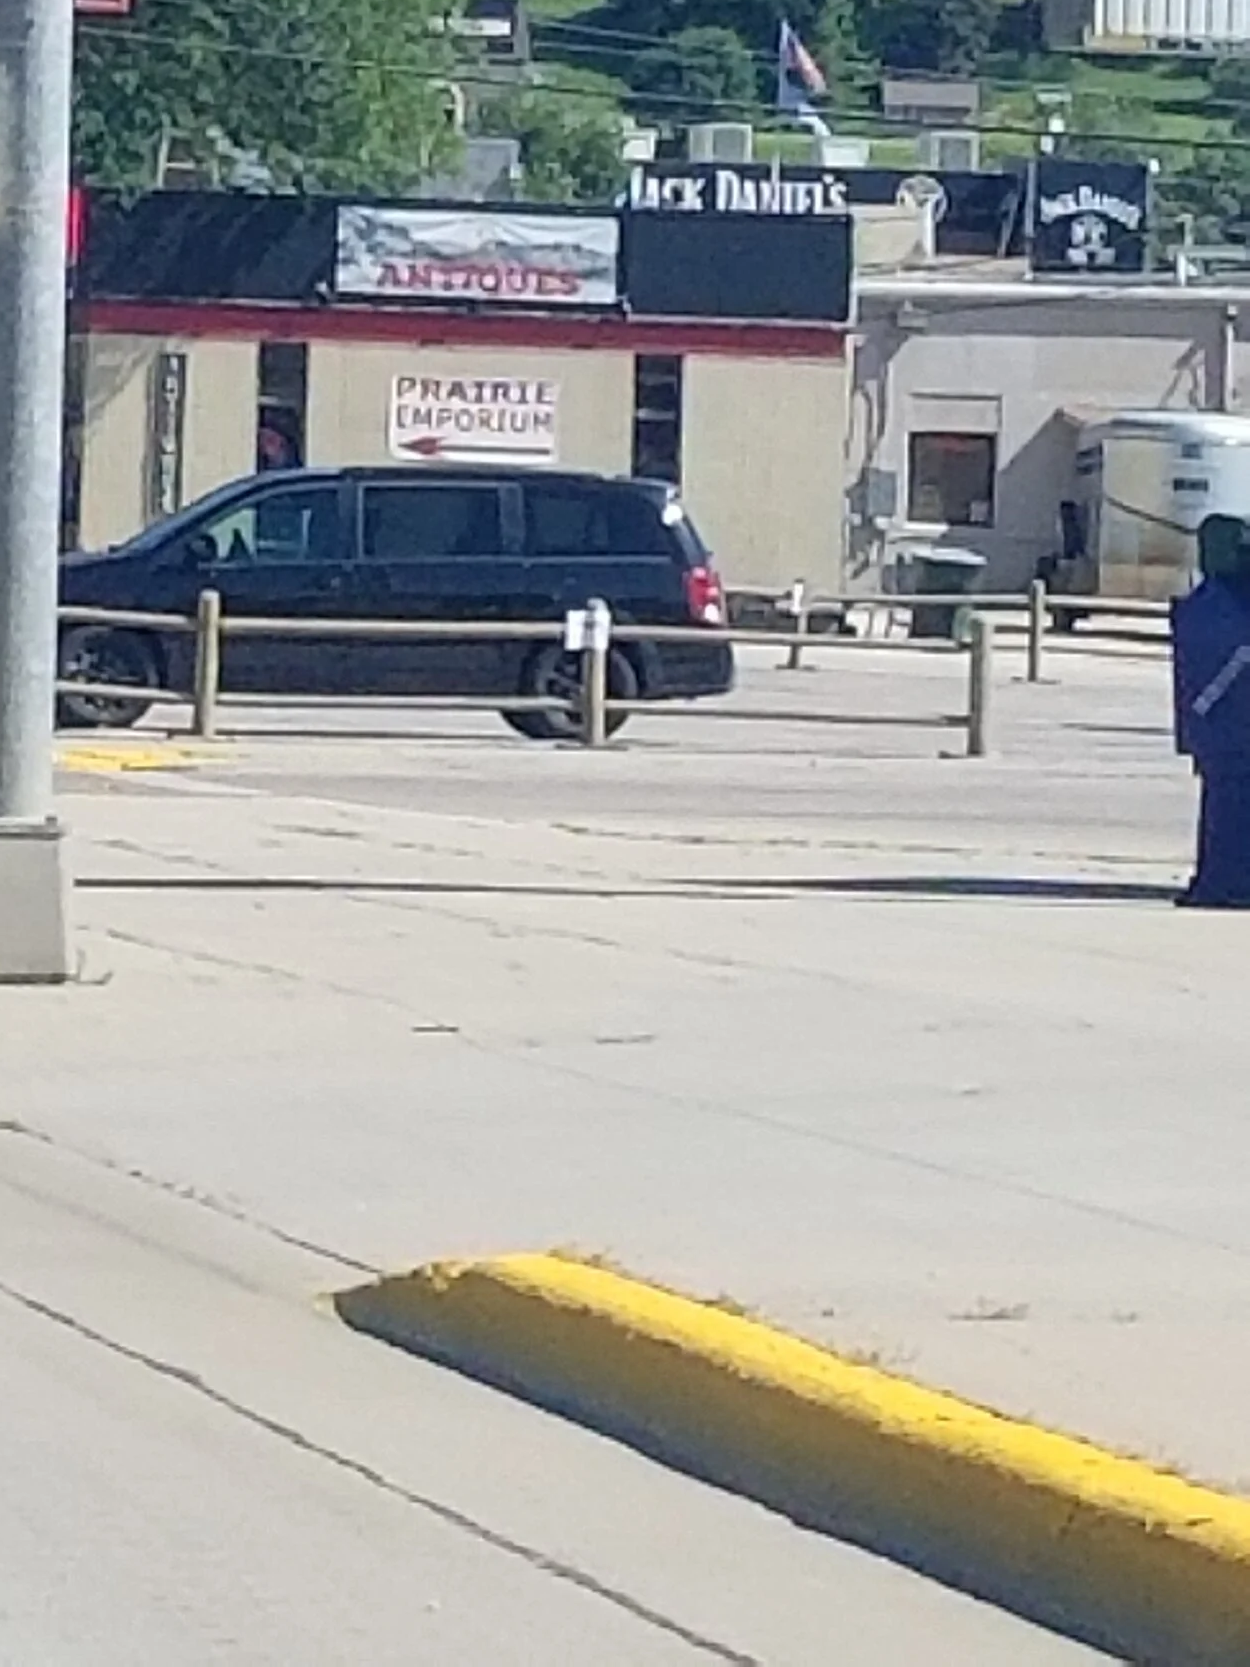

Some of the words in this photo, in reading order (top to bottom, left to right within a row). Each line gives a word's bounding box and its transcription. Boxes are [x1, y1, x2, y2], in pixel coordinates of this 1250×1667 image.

[374, 260, 582, 296] ANTIQUES
[396, 376, 554, 405] PRAIRIE
[395, 405, 552, 432] EMPORIUM
